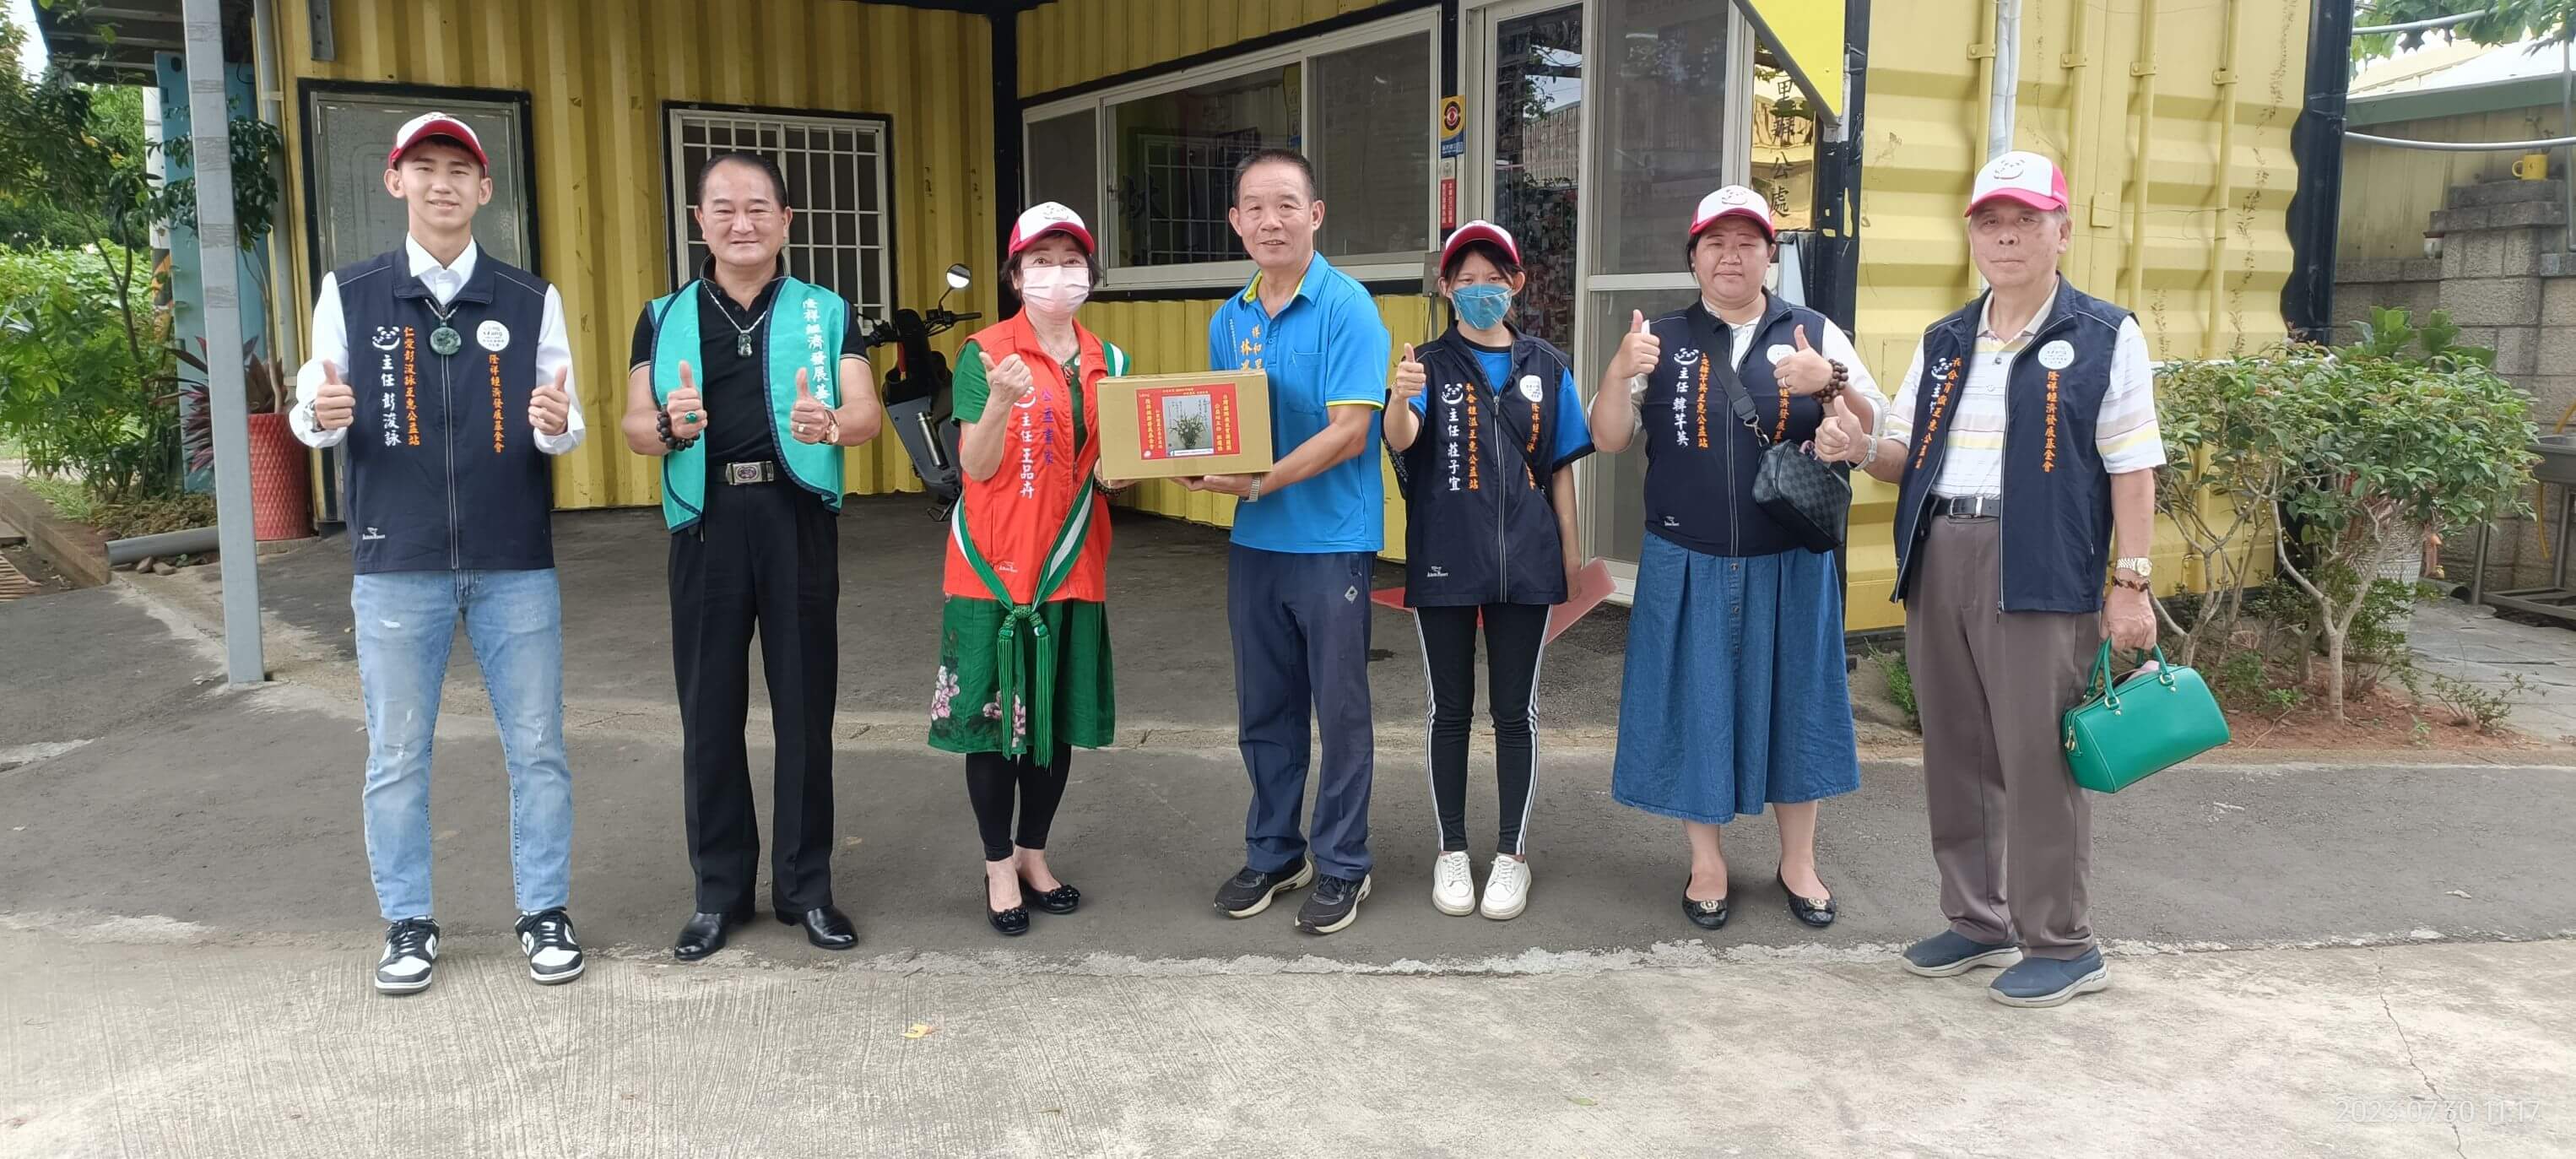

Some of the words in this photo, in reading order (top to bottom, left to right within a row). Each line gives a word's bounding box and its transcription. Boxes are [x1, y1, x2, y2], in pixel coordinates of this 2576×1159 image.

[381, 355, 395, 387] 主任
[1675, 367, 1690, 393] 主任
[488, 354, 505, 453] 隆祥經濟發展基金會
[1020, 413, 1032, 443] 主任
[1448, 408, 1460, 437] 主任
[2042, 371, 2059, 473] 隆祥經濟發展基金會
[1020, 447, 1035, 500] 王品卉
